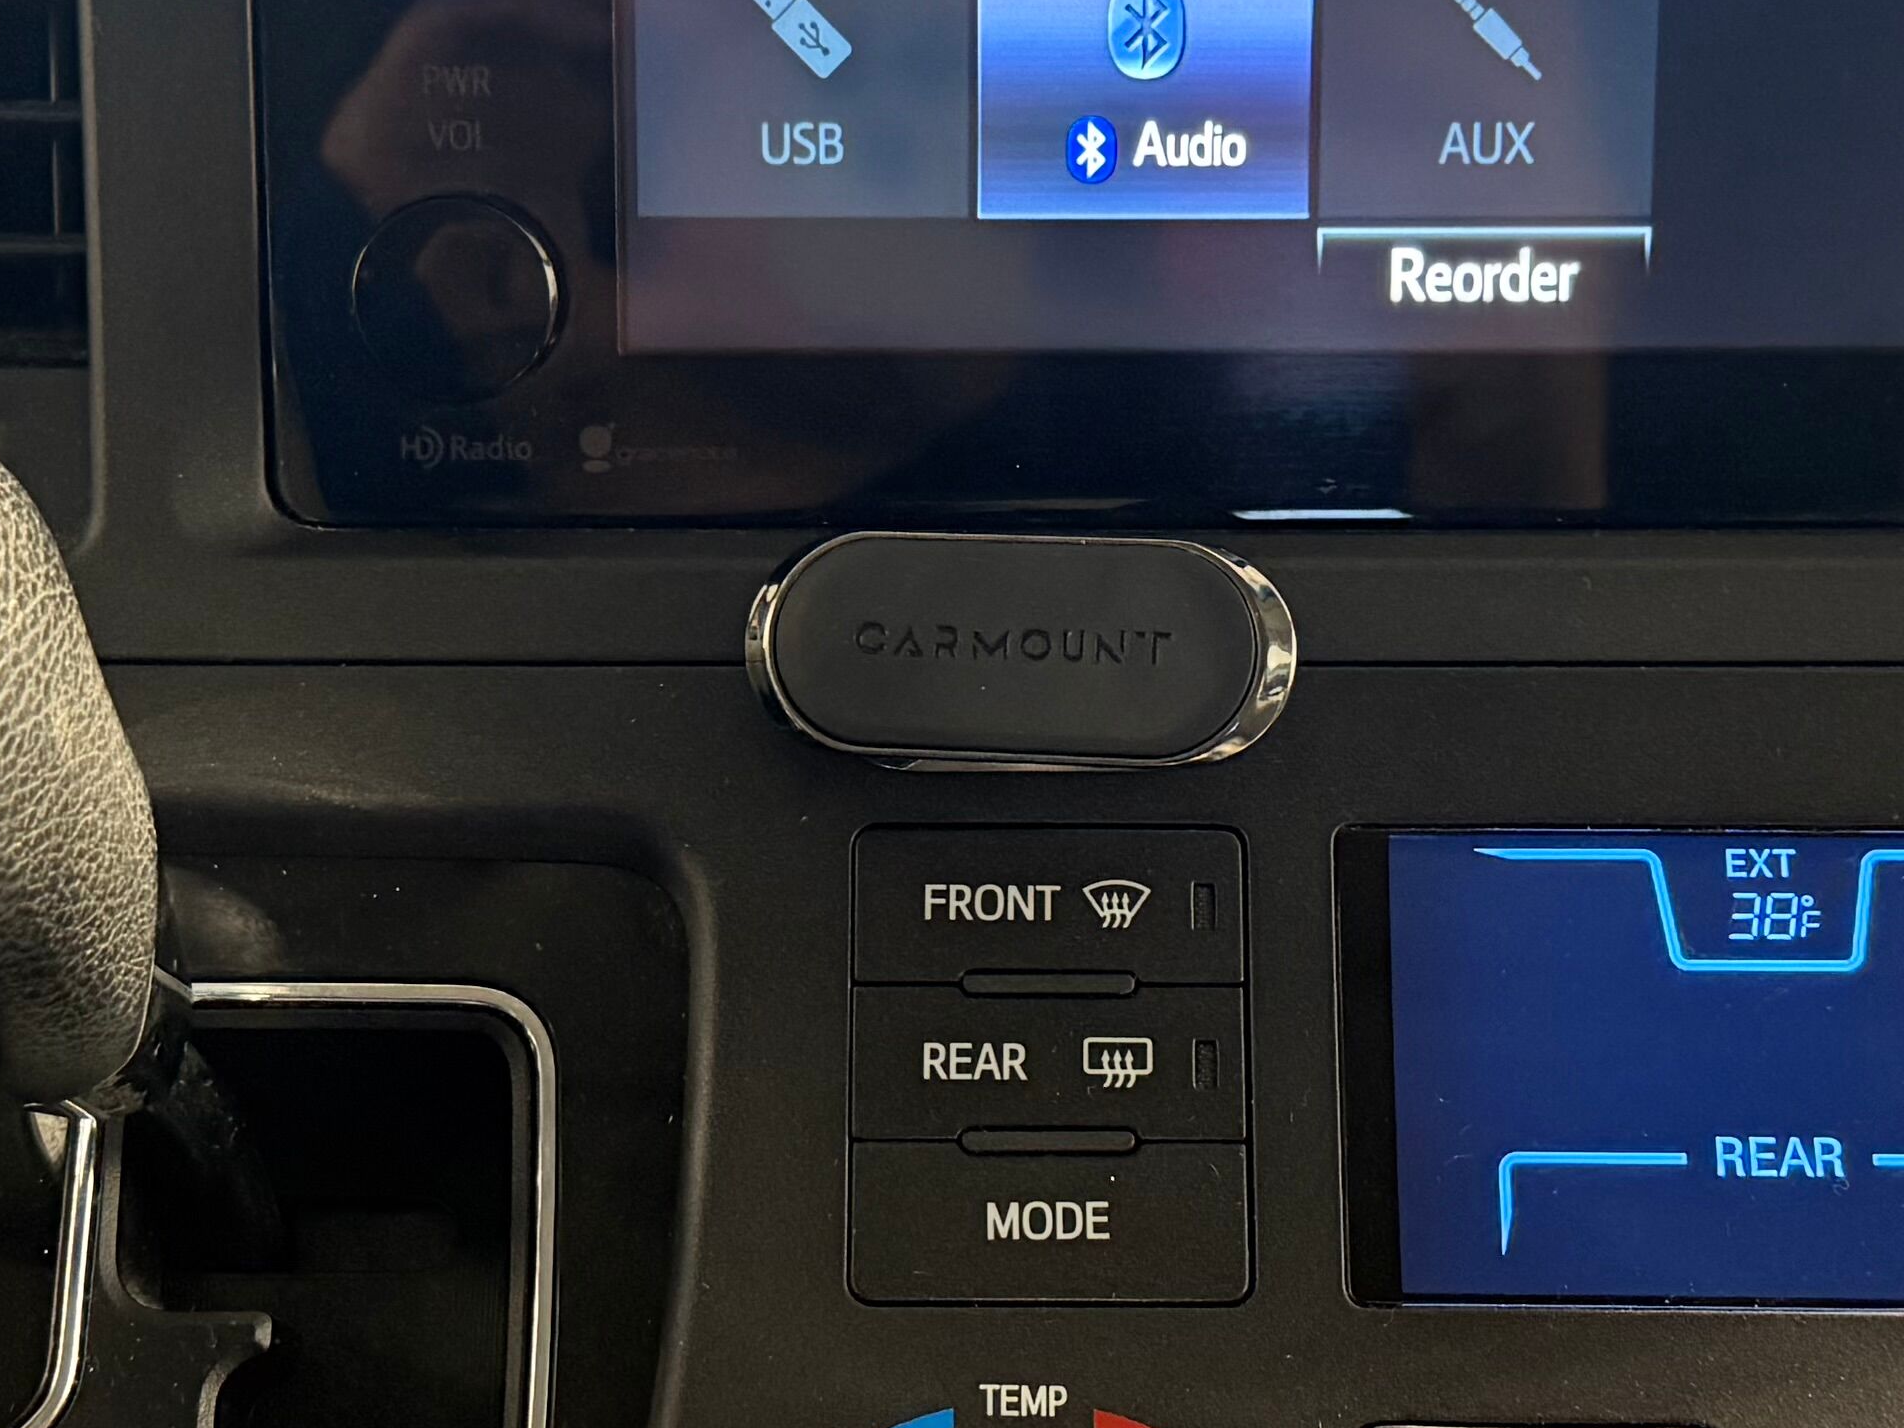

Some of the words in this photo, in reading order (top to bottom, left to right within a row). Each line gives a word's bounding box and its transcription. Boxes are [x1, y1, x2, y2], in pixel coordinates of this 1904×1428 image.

[422, 66, 492, 99] PWR
[427, 119, 485, 152] VOL
[760, 122, 845, 166] USB
[1132, 121, 1248, 169] Audio
[1438, 122, 1536, 166] AUX
[1390, 245, 1582, 304] Reorder
[450, 433, 533, 462] Radio
[855, 620, 1172, 665] CARMOUNT
[1725, 848, 1796, 878] EXT
[923, 884, 1061, 921] FRONT
[922, 1042, 1028, 1081] REAR
[1714, 1136, 1845, 1179] REAR
[986, 1200, 1110, 1240] MODE
[979, 1384, 1068, 1417] TEMP
